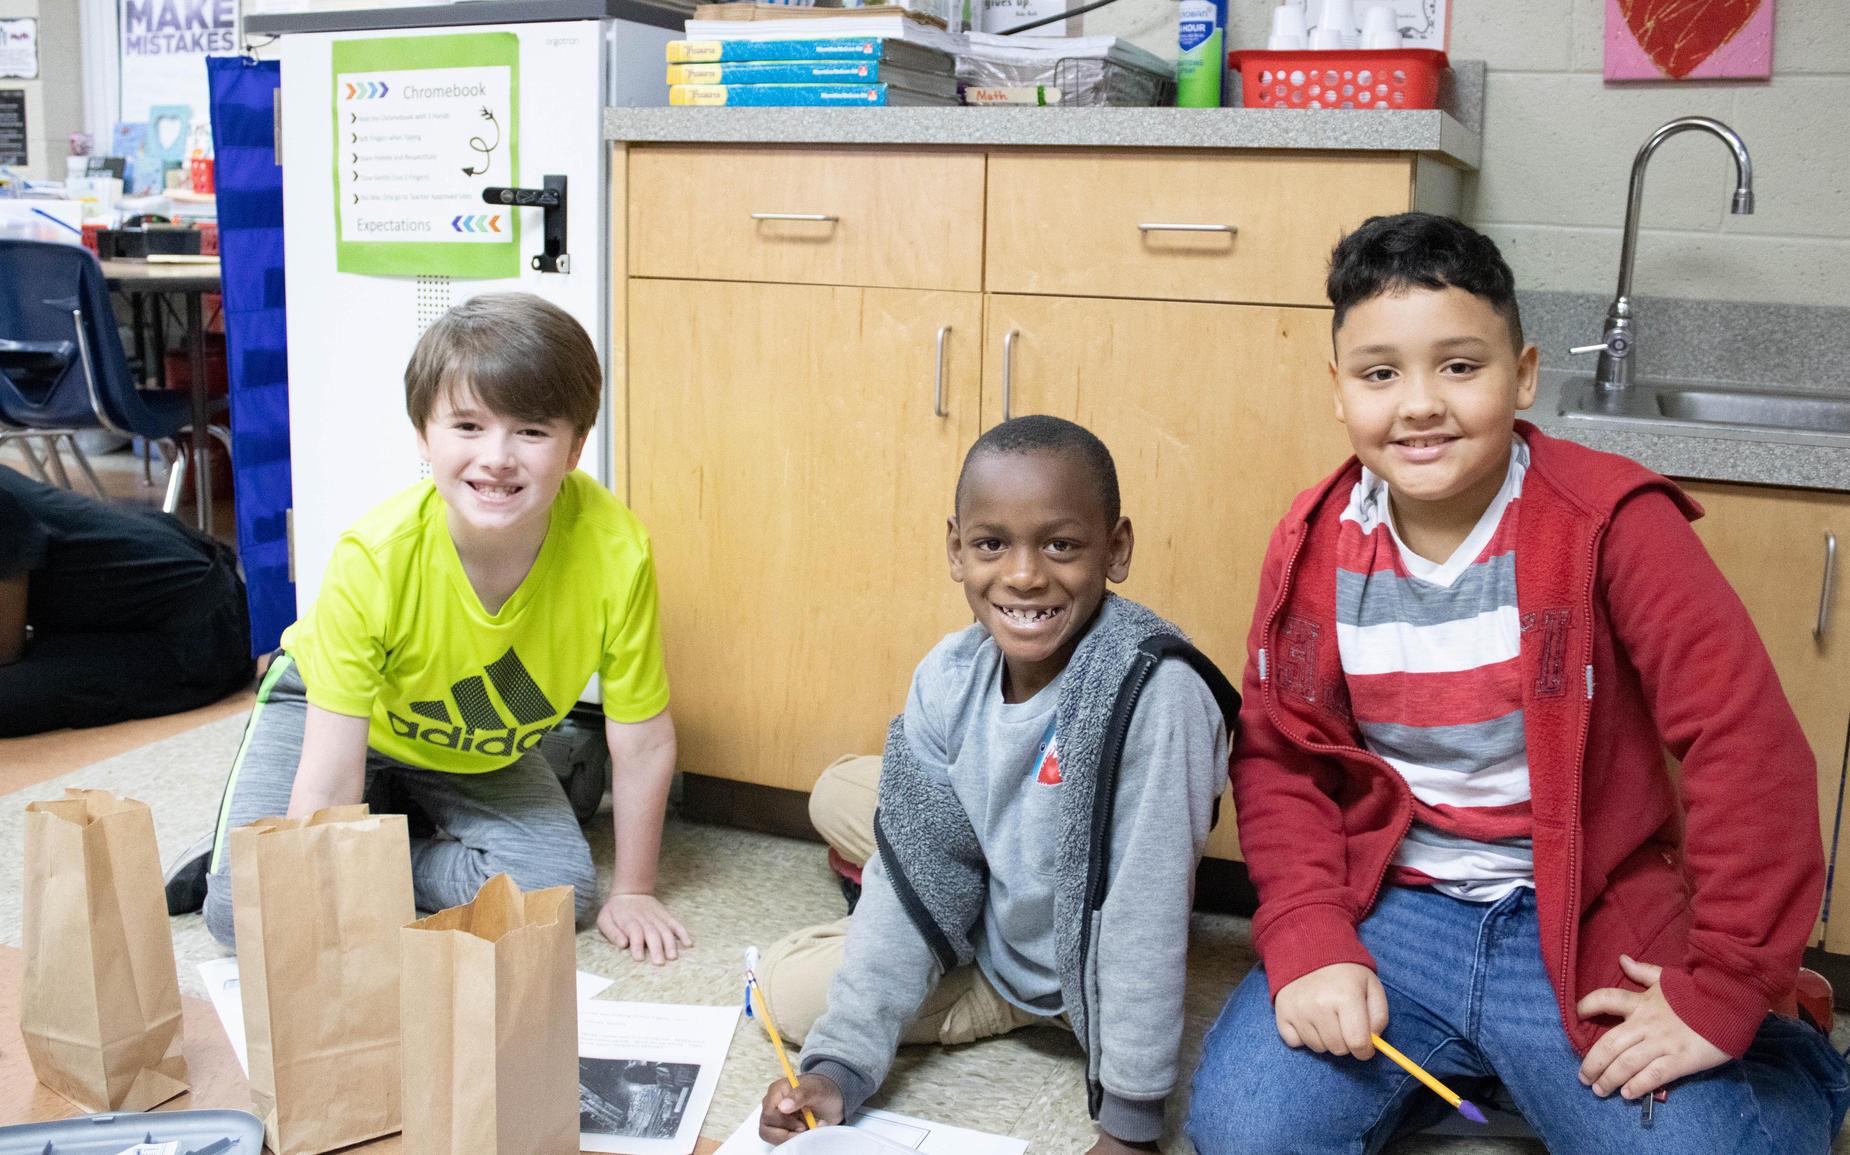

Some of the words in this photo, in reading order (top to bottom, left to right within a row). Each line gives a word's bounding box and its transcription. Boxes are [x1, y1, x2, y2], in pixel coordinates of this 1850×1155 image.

[985, 0, 1012, 9] gives
[127, 0, 234, 32] MAKE
[1183, 24, 1206, 32] HOUR
[127, 32, 234, 55] MISTAKES
[403, 82, 487, 100] Chromebook
[976, 90, 1008, 100] Math
[357, 217, 431, 234] Expectations
